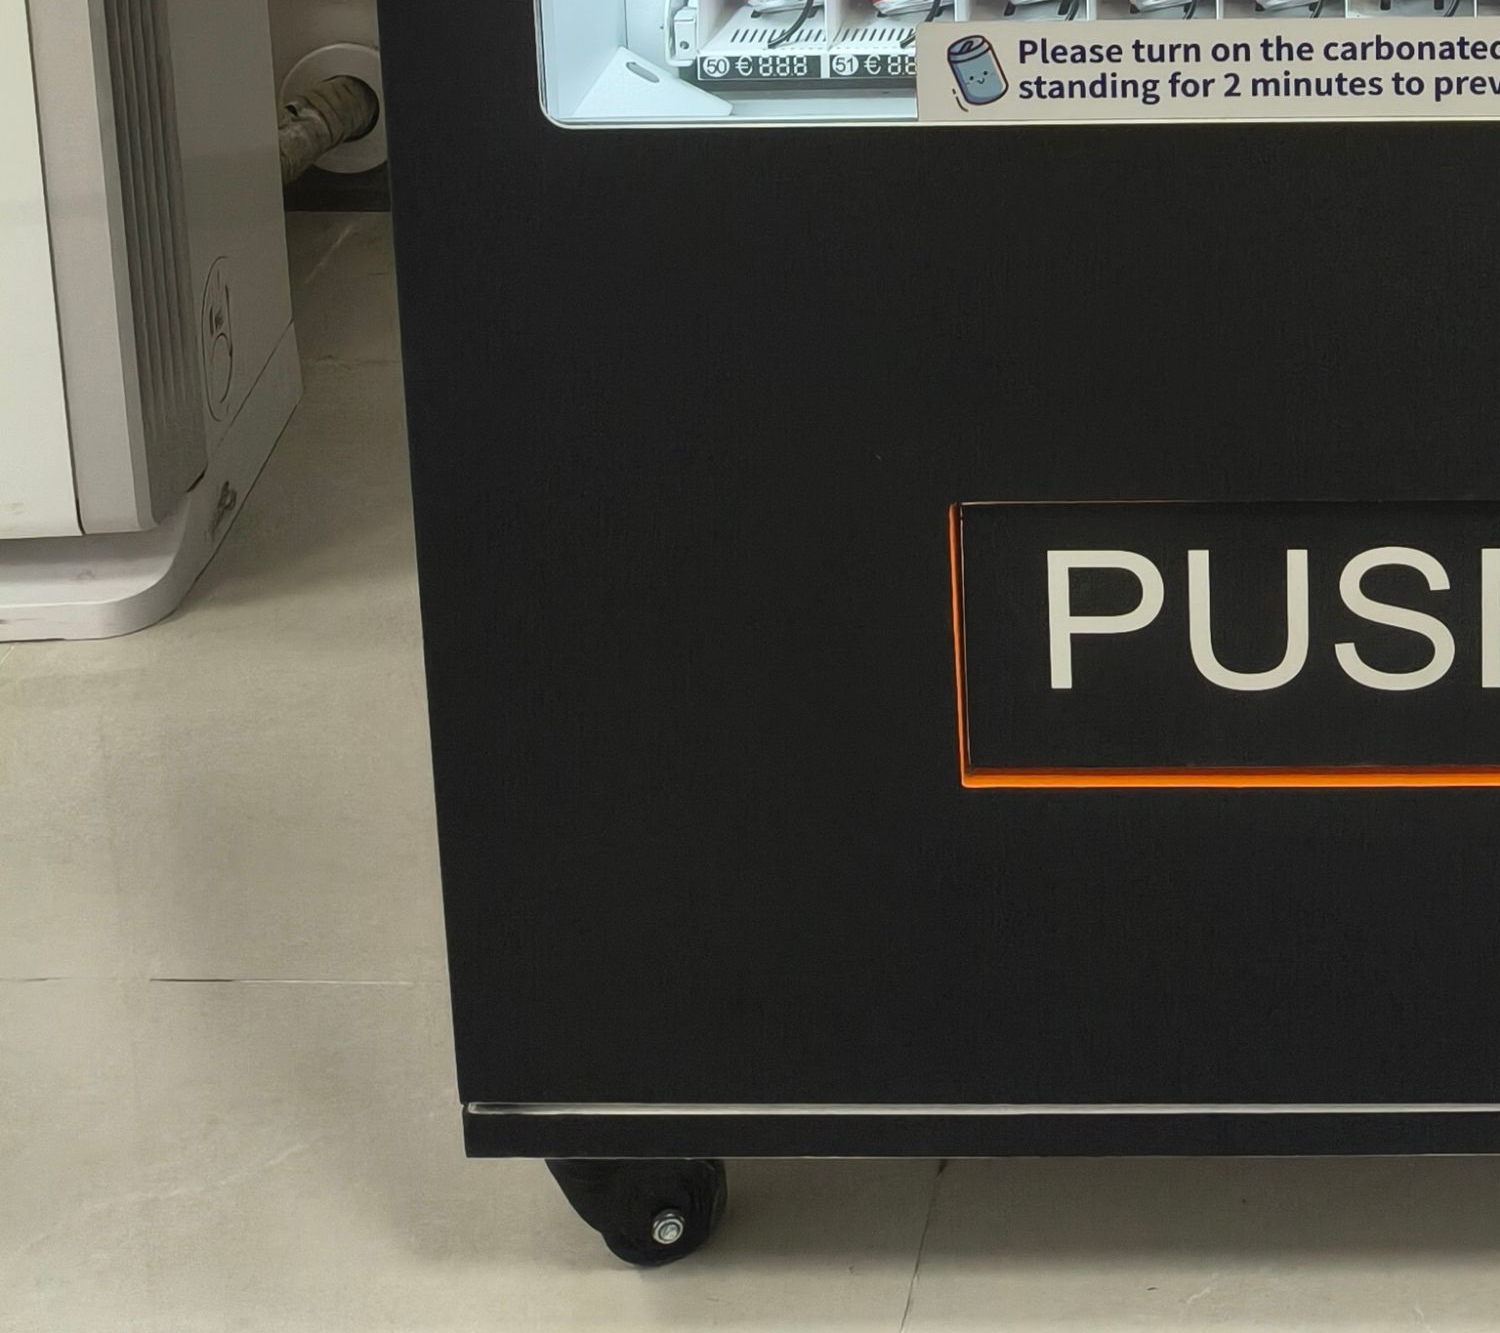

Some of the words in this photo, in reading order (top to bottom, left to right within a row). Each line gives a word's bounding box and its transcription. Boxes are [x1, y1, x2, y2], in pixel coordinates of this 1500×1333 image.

[1020, 38, 1122, 64] Please
[1132, 40, 1200, 62] turn
[1212, 43, 1250, 62] on
[1260, 36, 1314, 61] the
[706, 60, 726, 74] 50
[1020, 72, 1160, 105] standing
[1168, 72, 1215, 97] for
[1224, 73, 1241, 97] 2
[1252, 70, 1383, 96] minutes
[1392, 72, 1424, 95] to
